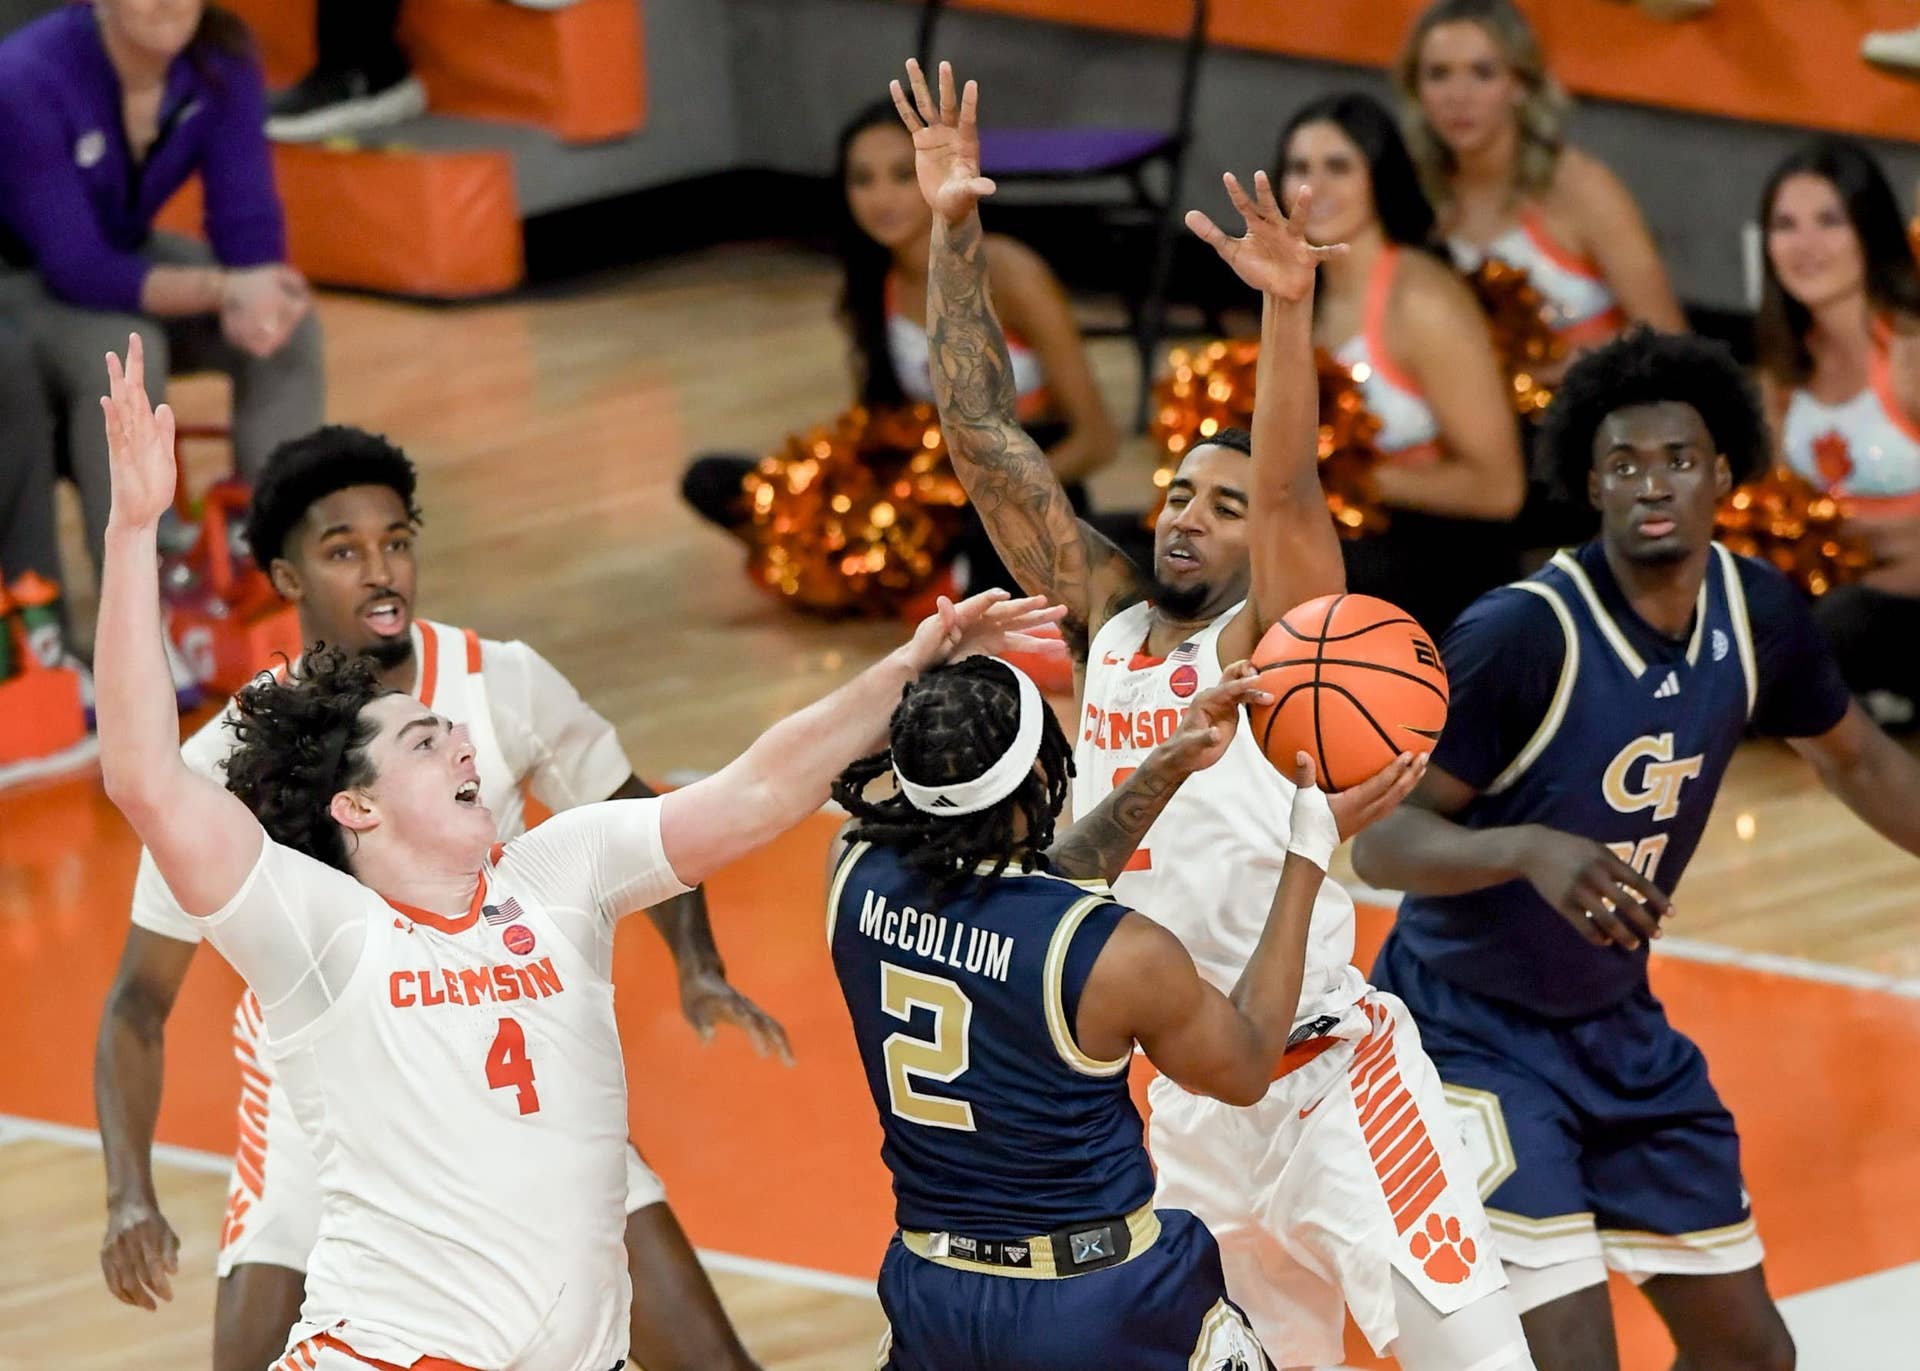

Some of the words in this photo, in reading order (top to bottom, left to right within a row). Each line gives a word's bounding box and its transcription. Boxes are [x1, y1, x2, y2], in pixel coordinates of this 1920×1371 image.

[1602, 732, 1704, 821] GT
[859, 889, 1014, 982] McCOLLUM
[485, 1018, 540, 1115] 4
[880, 960, 978, 1131] 2
